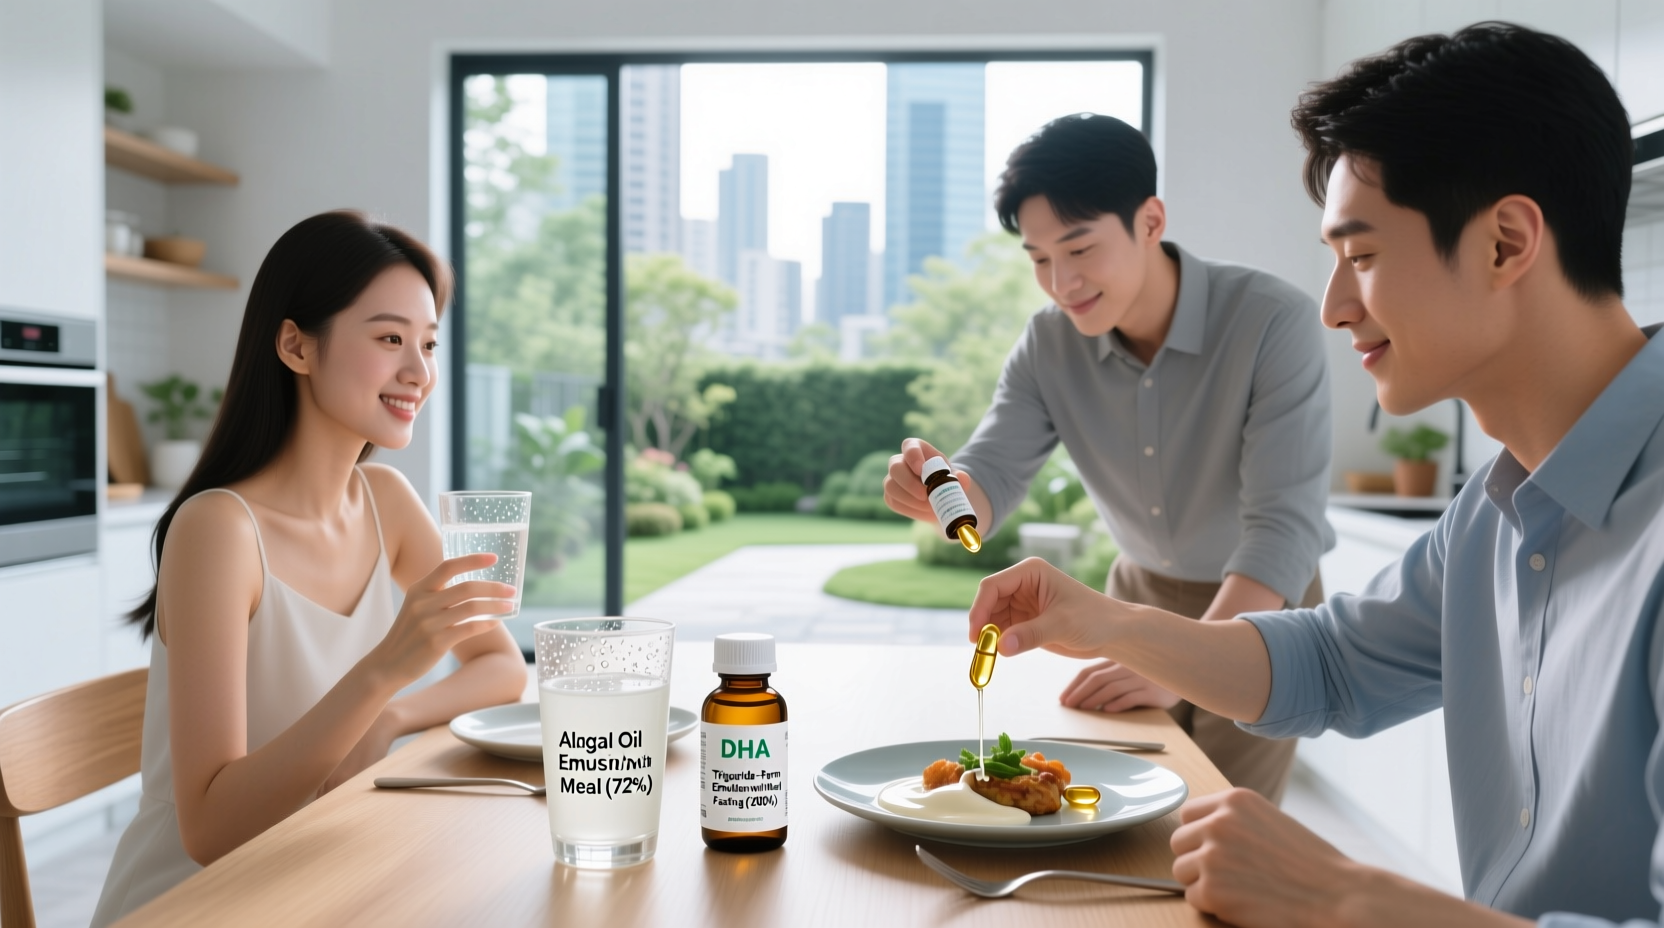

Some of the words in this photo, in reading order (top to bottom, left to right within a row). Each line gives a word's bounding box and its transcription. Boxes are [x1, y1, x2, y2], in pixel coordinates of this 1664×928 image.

[618, 730, 642, 748] Oil
[721, 738, 771, 759] DHA
[561, 777, 602, 794] Meal
[606, 774, 653, 800] (72%)
